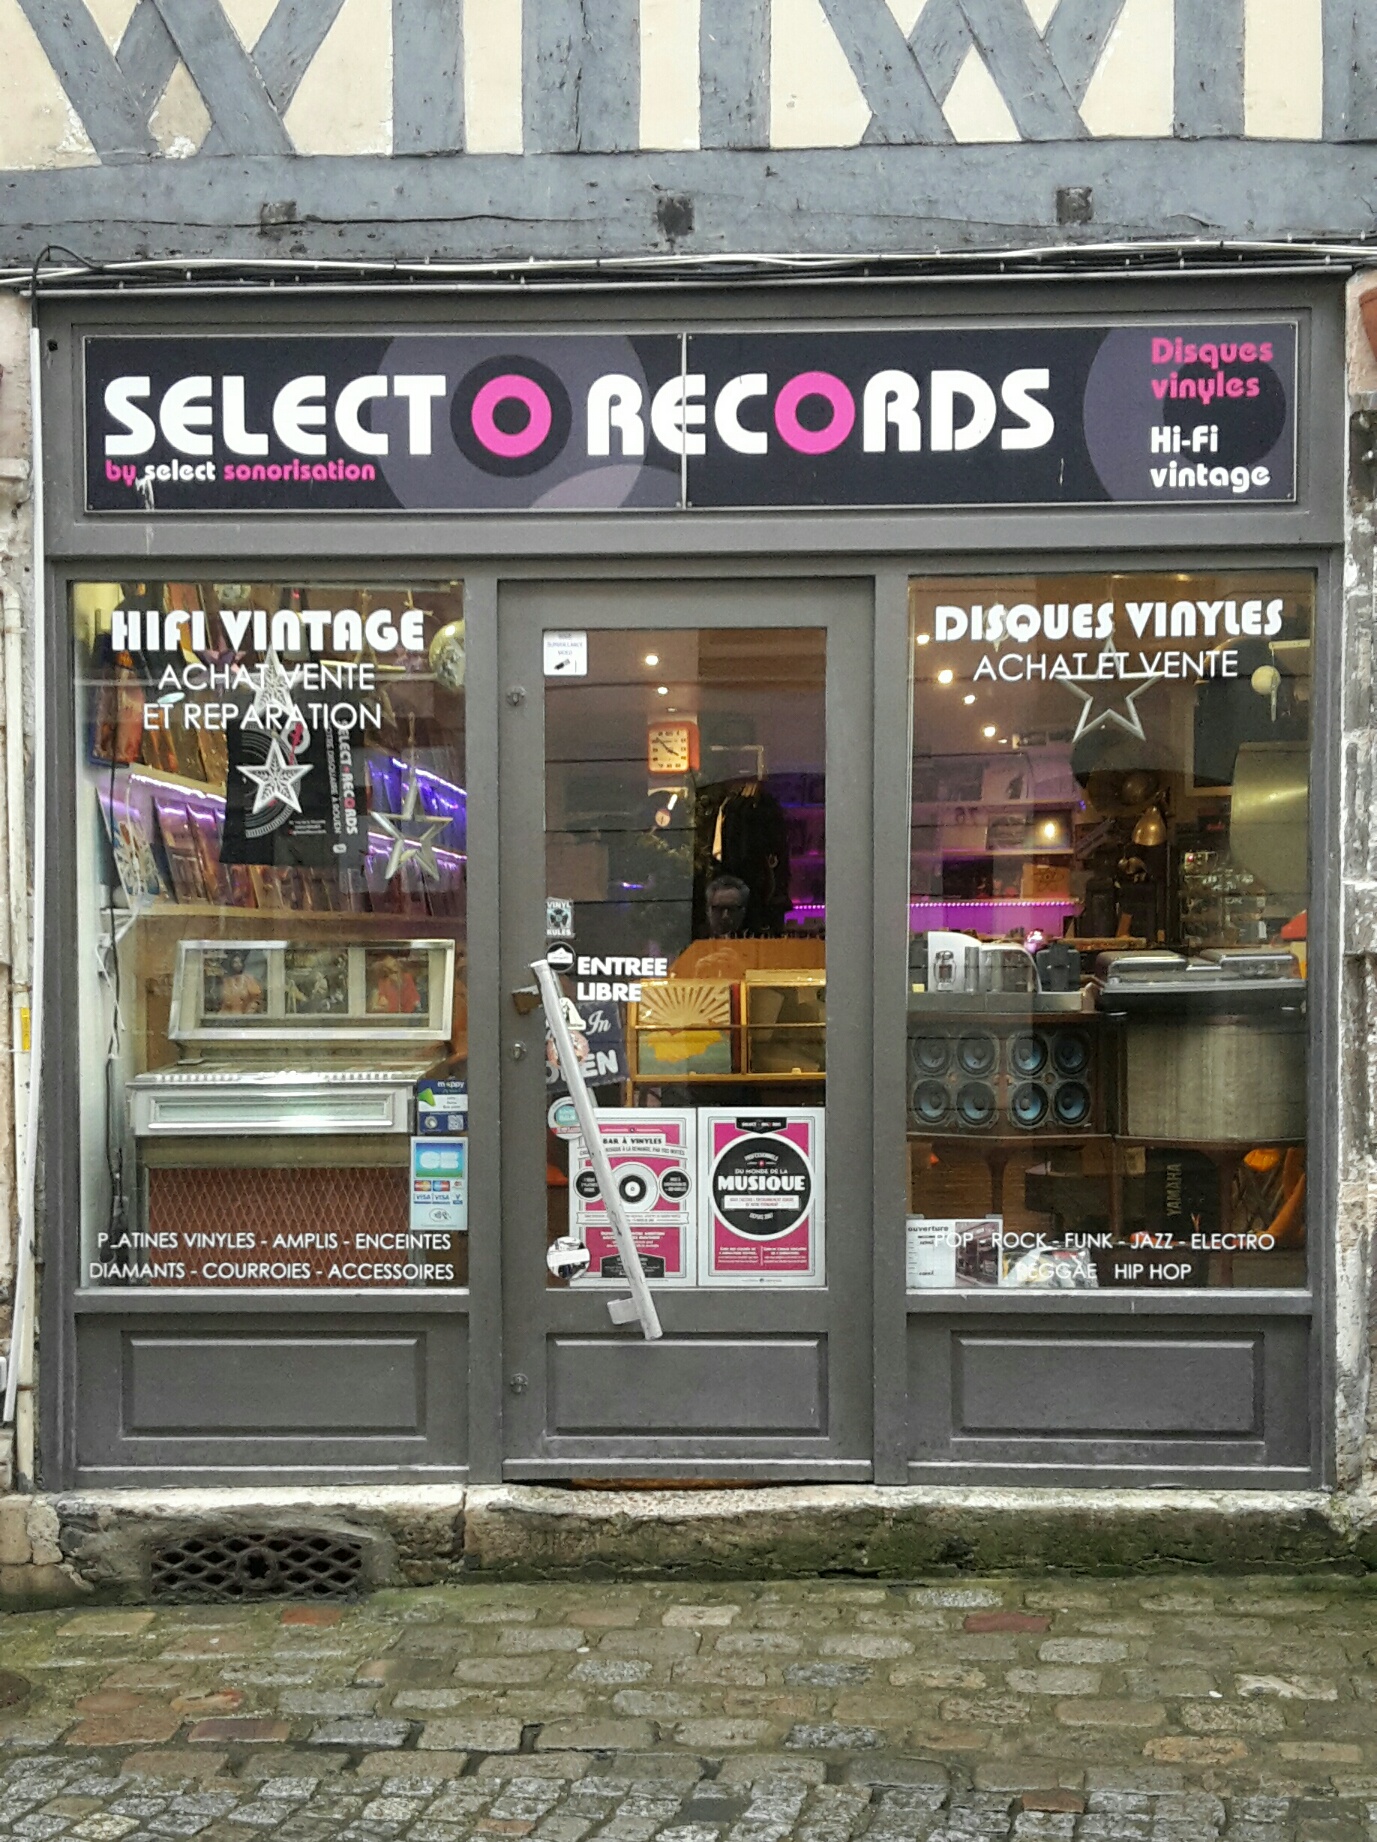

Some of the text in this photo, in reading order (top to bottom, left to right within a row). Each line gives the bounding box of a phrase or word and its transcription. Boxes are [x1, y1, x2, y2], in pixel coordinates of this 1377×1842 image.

[1151, 336, 1274, 370] Disques
[1151, 371, 1260, 405] vinyles
[104, 374, 447, 457] SELECT
[587, 367, 1055, 457] RECORDS
[1150, 424, 1219, 454] Hi-Fi
[104, 458, 376, 485] by select sonorisation
[1150, 460, 1271, 493] vintage
[111, 609, 425, 652] HIFI VINTAGE
[934, 599, 1284, 643] DISQUES VINYLES
[158, 664, 375, 691] ACHAT VENTE
[973, 650, 1239, 682] ACHAT ET VENTE
[143, 702, 382, 731] ET REPARATION
[577, 957, 668, 976] ENTREE
[577, 982, 642, 1002] LIBRE
[585, 1010, 611, 1035] In
[717, 1175, 805, 1191] MUSIQUE
[1166, 1163, 1182, 1217] YAMAHA
[183, 1232, 256, 1249] VINYLES
[272, 1233, 338, 1249] AMPLIS
[355, 1233, 451, 1250] ENCEINTES
[934, 1232, 974, 1248] POP
[991, 1232, 1048, 1249] ROCK
[1064, 1233, 1113, 1249] FUNK
[1130, 1233, 1174, 1249] JAZZ
[1190, 1233, 1275, 1251] ELECTRO
[89, 1262, 185, 1279] DIAMANTS
[202, 1262, 311, 1279] COURROIES
[328, 1263, 455, 1280] ACCESSOIRES
[1114, 1264, 1144, 1279] HIP
[1149, 1264, 1192, 1280] HOP
